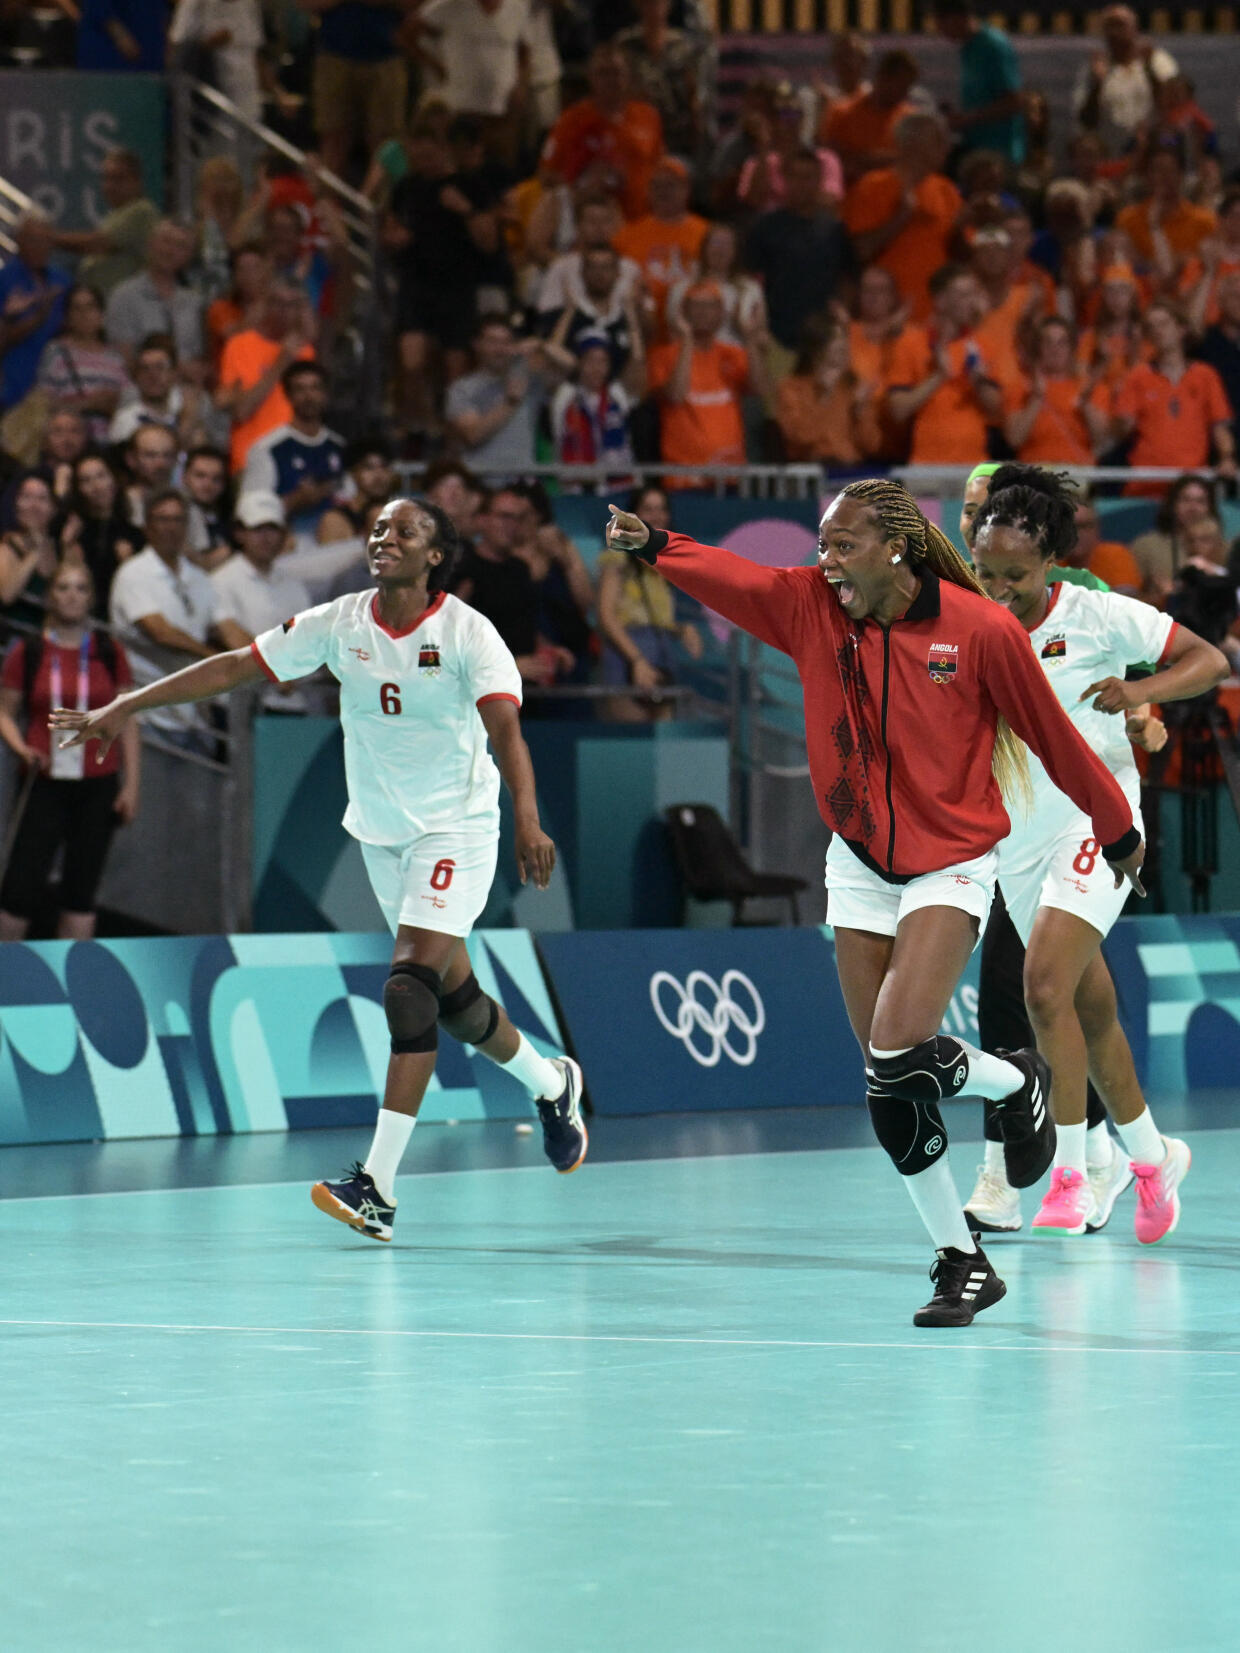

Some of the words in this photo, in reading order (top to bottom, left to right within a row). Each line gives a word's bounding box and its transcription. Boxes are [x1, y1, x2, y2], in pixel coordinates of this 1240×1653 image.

[929, 643, 959, 653] ANGOLA
[380, 682, 402, 715] 6
[1072, 838, 1101, 875] 8
[430, 858, 457, 891] 6
[941, 984, 980, 1034] IS
